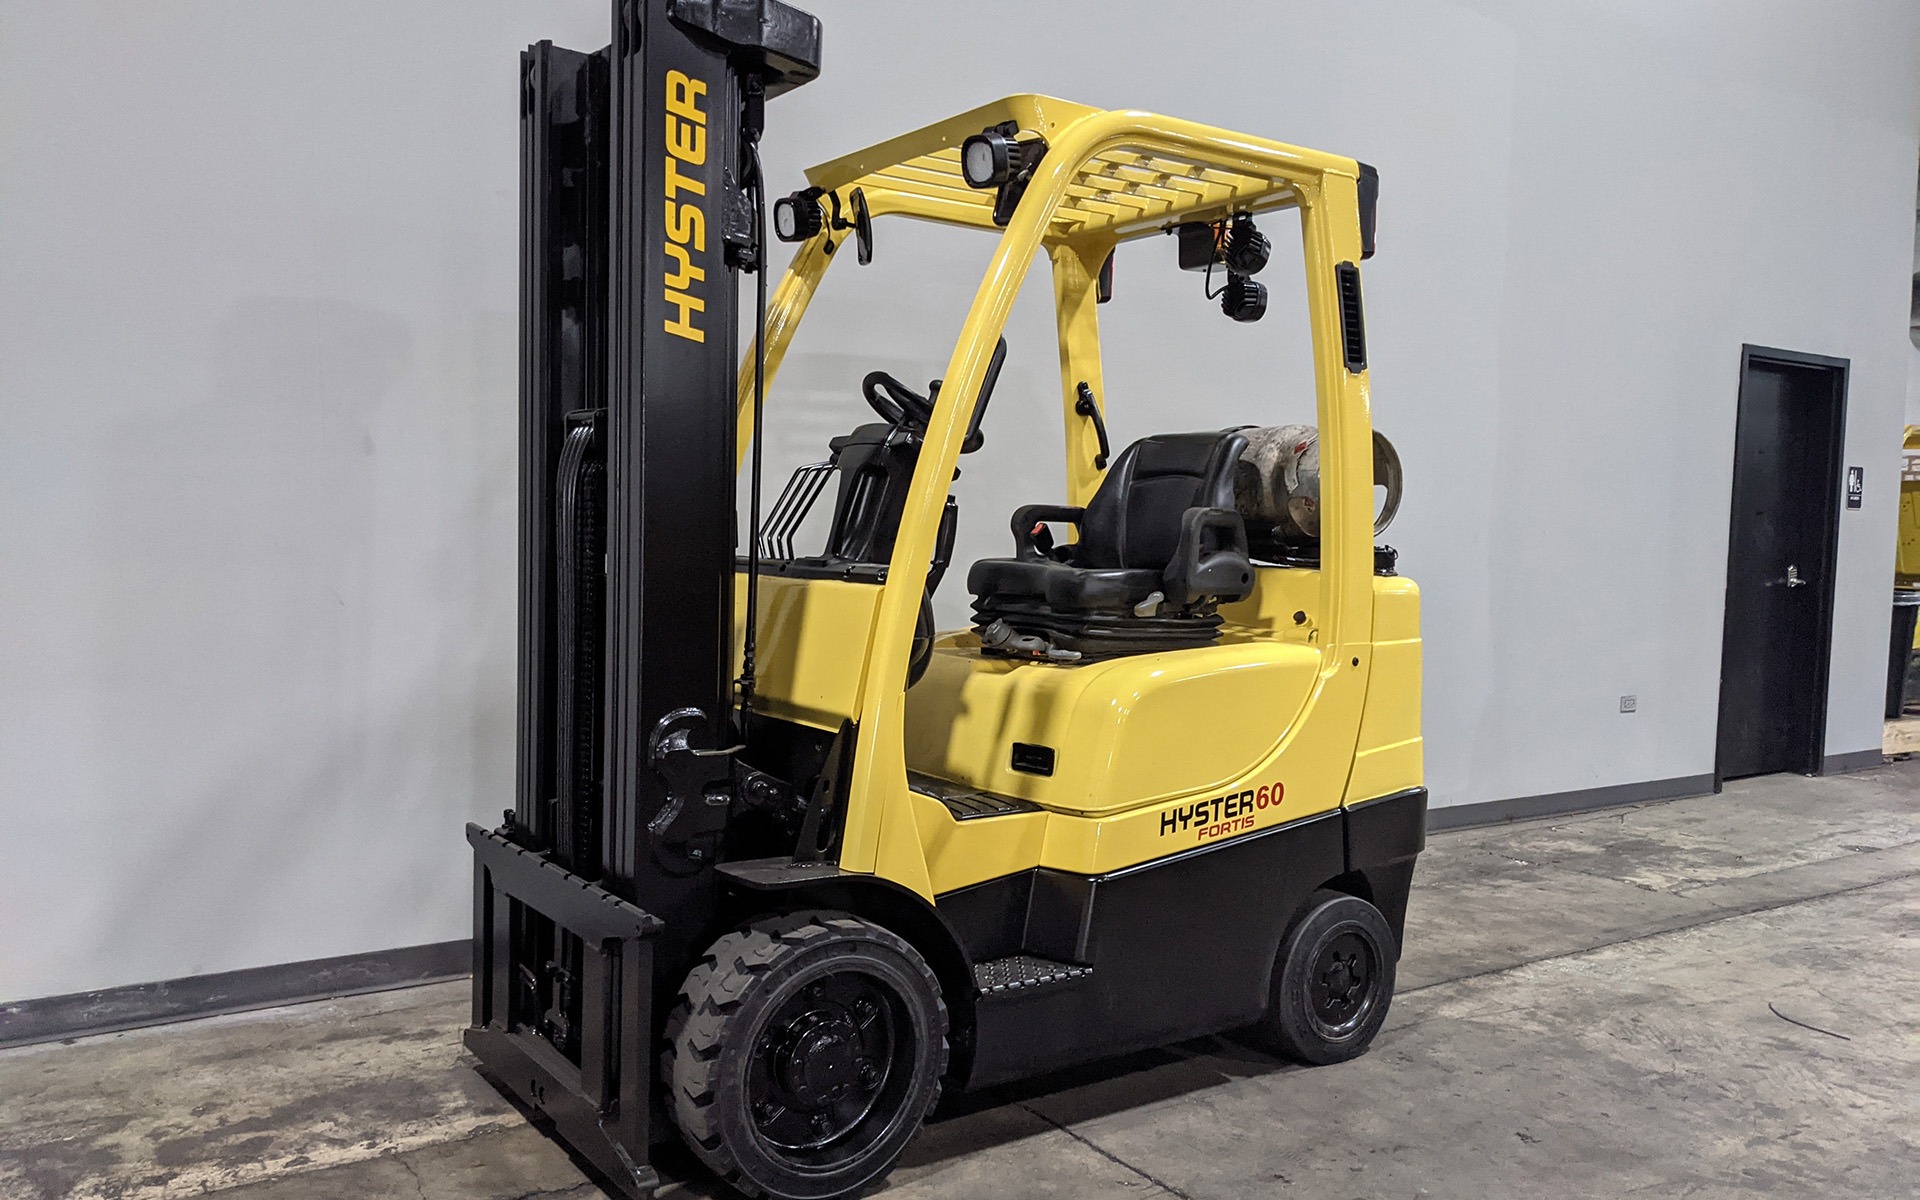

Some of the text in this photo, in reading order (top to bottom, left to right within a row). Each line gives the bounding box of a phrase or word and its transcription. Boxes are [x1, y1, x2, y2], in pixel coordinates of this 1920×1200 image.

[664, 69, 707, 344] HYSTER
[1160, 782, 1285, 837] HYSTER 60
[1198, 815, 1255, 841] FORTIS
